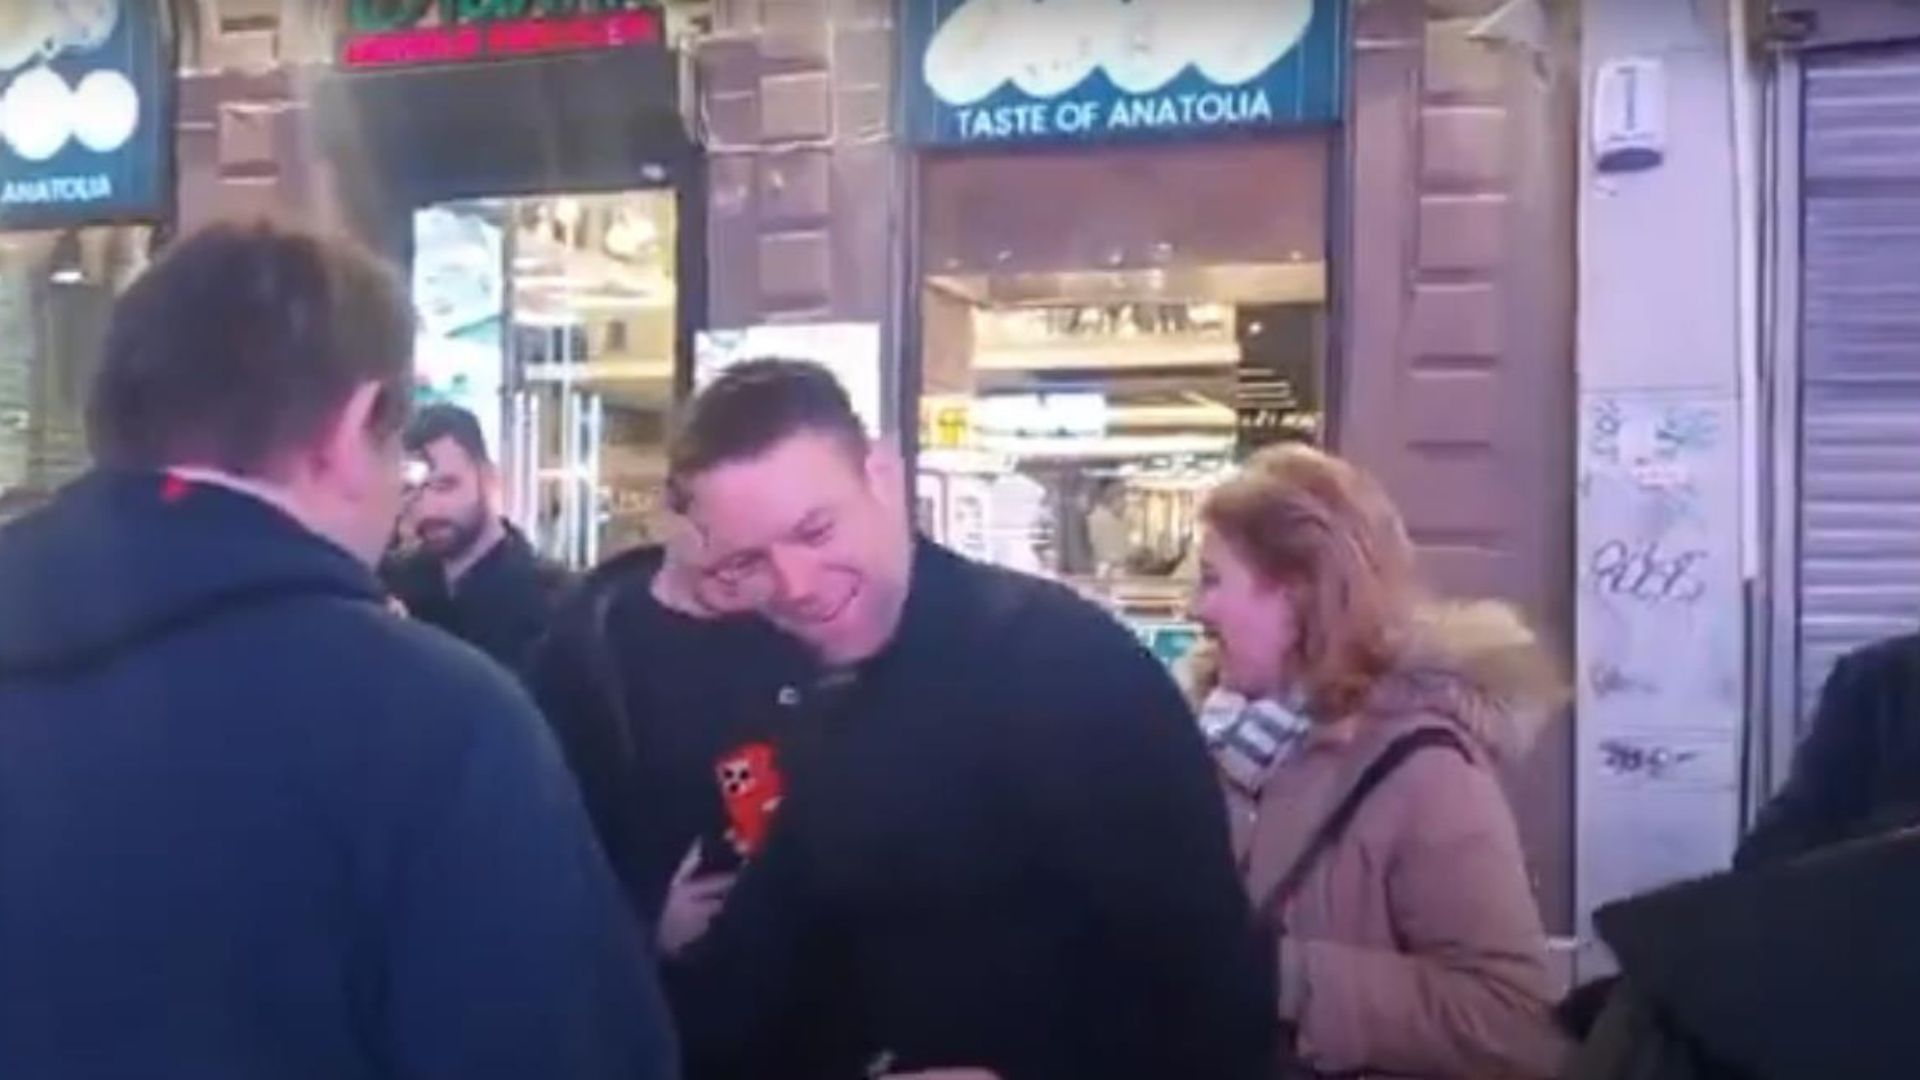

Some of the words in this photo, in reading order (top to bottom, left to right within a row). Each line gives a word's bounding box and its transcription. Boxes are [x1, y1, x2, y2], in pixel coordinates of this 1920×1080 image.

[956, 105, 1047, 138] TASTE
[1054, 101, 1100, 131] OF
[1107, 90, 1272, 129] ANATOLIA
[1, 173, 113, 203] ANATOLIA
